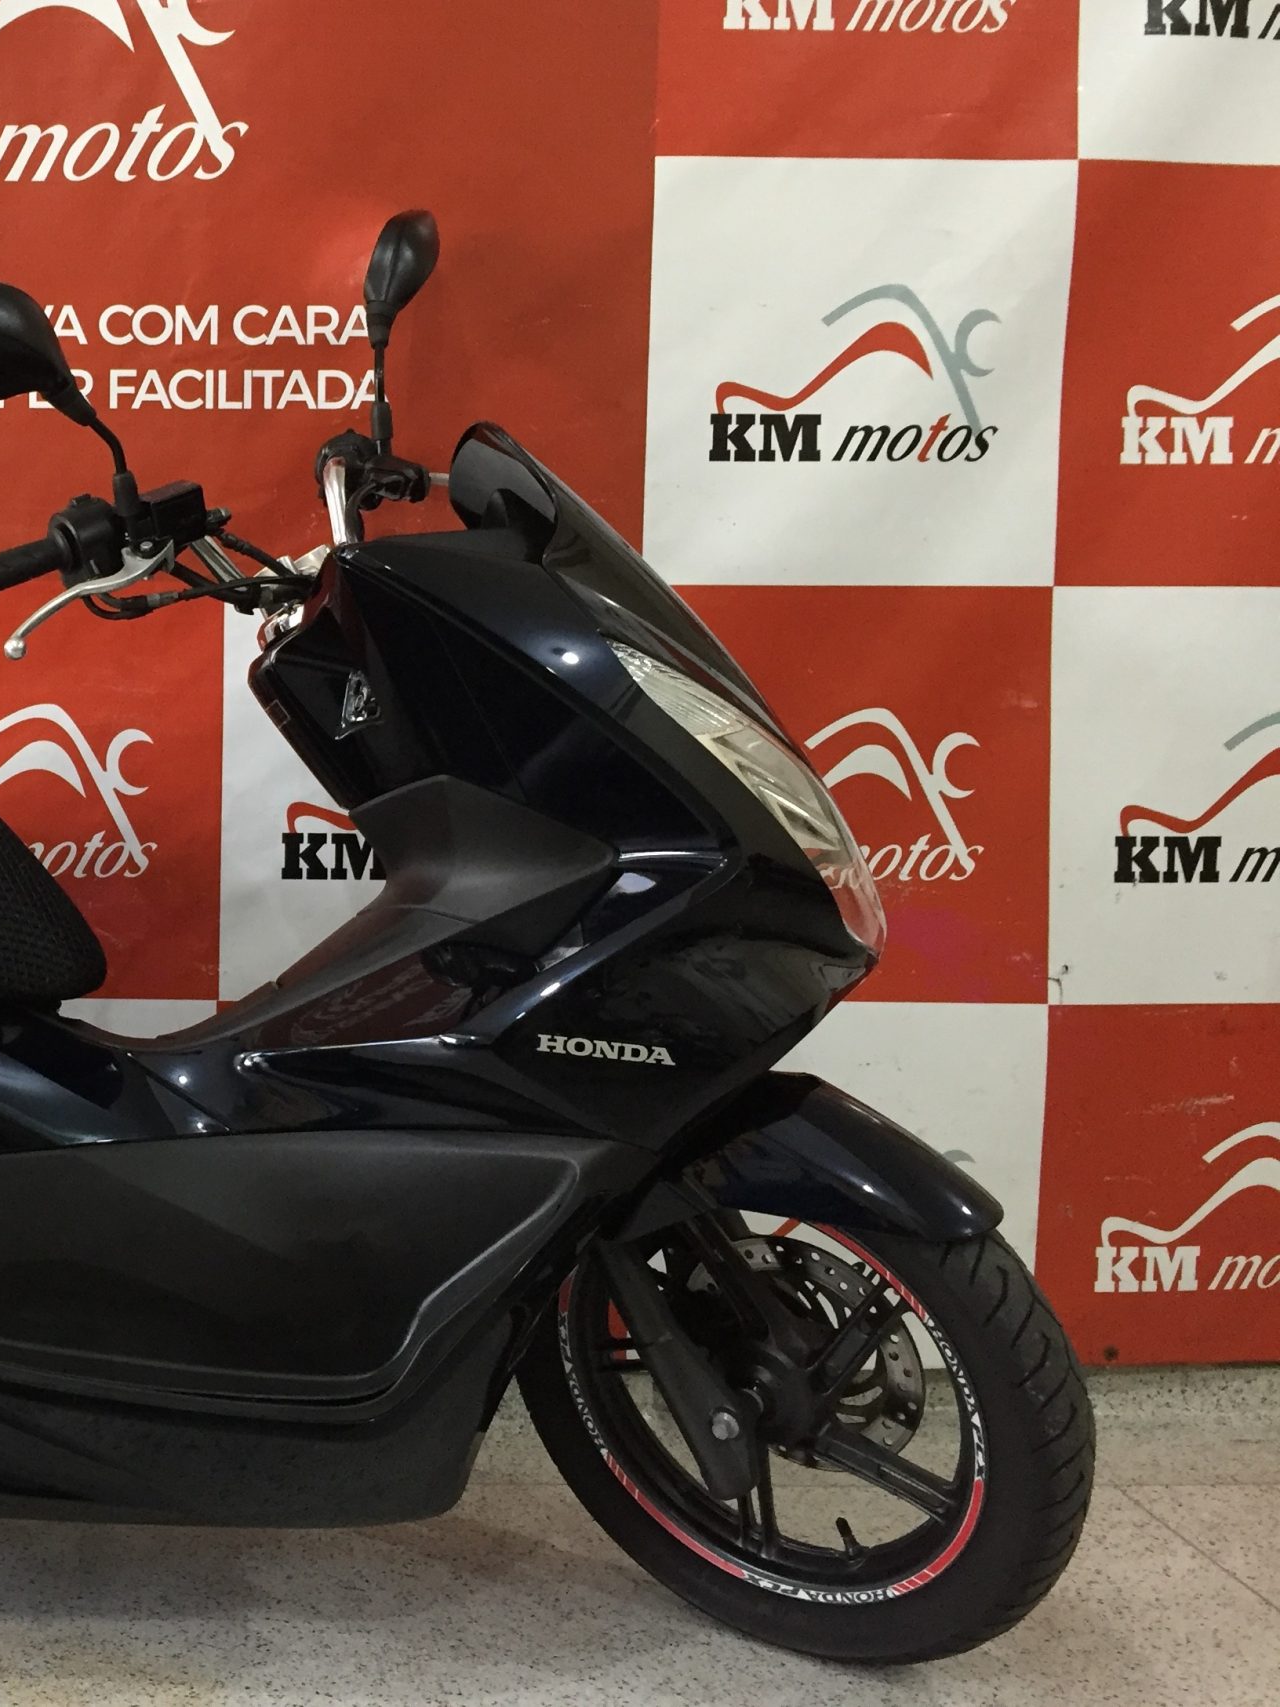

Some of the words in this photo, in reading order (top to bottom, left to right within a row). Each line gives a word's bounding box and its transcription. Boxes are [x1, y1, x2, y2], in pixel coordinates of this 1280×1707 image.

[98, 304, 219, 345] COM
[232, 304, 372, 345] CARA
[109, 369, 389, 410] FACILITADA
[709, 413, 822, 462] KM
[832, 413, 999, 462] motos
[1120, 416, 1234, 465] KM
[27, 830, 158, 879] otos
[858, 833, 984, 881] otos
[1114, 836, 1222, 883] KM
[536, 1033, 676, 1066] HONDA
[1094, 1246, 1200, 1293] KM
